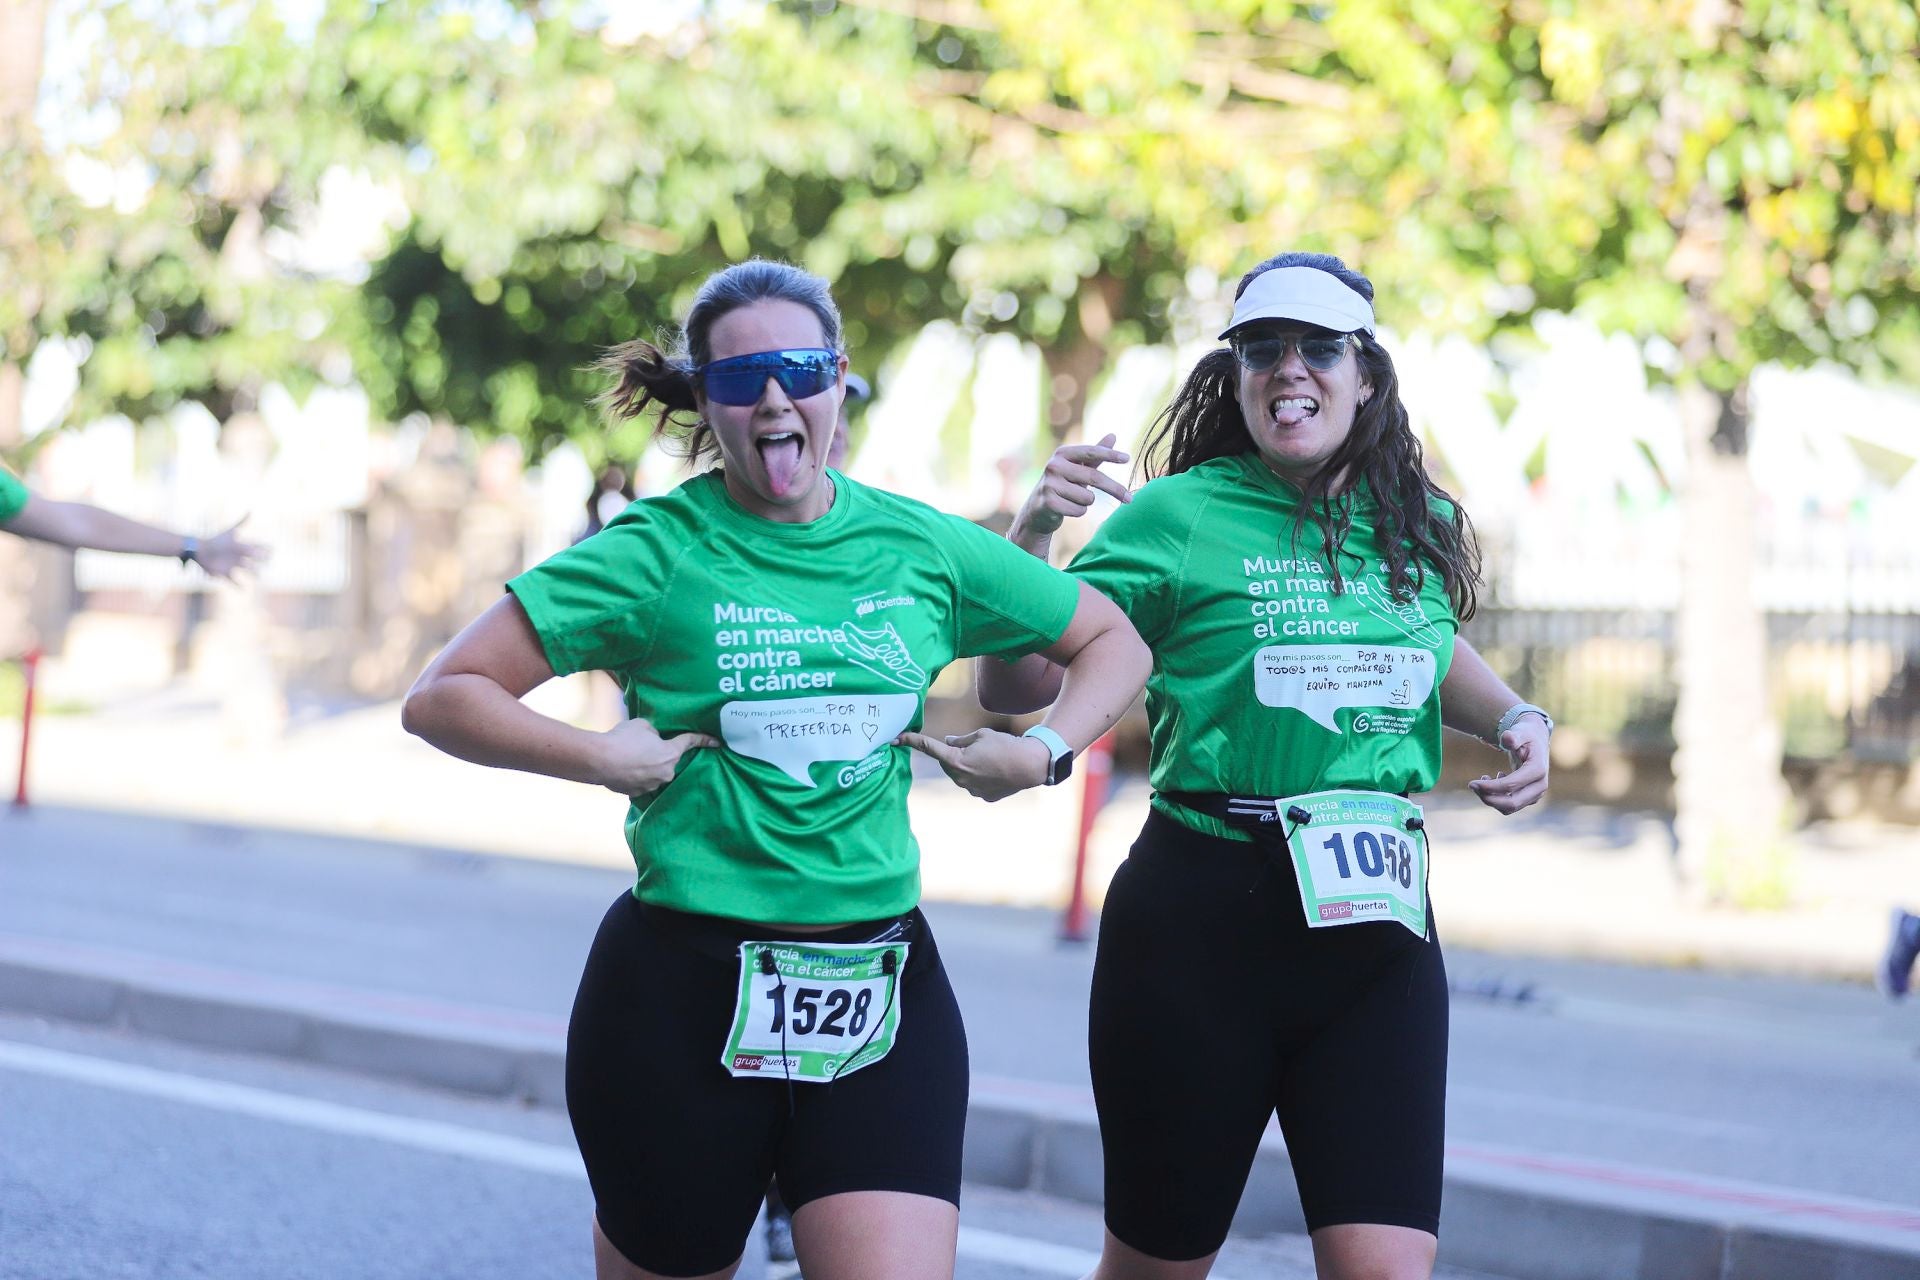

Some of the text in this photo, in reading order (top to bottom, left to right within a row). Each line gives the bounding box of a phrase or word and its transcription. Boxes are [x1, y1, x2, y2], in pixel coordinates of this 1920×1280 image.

[1243, 556, 1324, 576] Murcia
[1248, 579, 1279, 596] en
[714, 602, 798, 624] Murcia
[1251, 595, 1329, 617] contra
[715, 625, 848, 646] en marcha
[1253, 614, 1360, 639] el cáncer
[717, 647, 801, 670] contra
[1263, 654, 1280, 663] Hoy
[1300, 654, 1326, 662] pasos
[1357, 650, 1377, 662] POR
[1400, 653, 1406, 664] Y
[1410, 653, 1425, 664] POR
[1265, 665, 1306, 675] TOD@S
[719, 669, 836, 693] el cáncer
[1347, 679, 1383, 689] MANZANA
[730, 709, 750, 720] Hoy
[751, 709, 768, 718] mis
[769, 708, 797, 719] pasos
[826, 703, 856, 716] POR
[763, 721, 852, 740] PREFERIDA
[1341, 800, 1357, 809] en
[1359, 799, 1398, 813] marcha
[1308, 812, 1340, 824] ntra
[1342, 810, 1354, 821] el
[1356, 810, 1393, 823] cáncer
[1323, 831, 1412, 889] 1058
[802, 952, 820, 963] en
[753, 959, 795, 973] ctra
[797, 962, 811, 975] el
[813, 965, 856, 977] cáncer
[766, 984, 872, 1037] 1528
